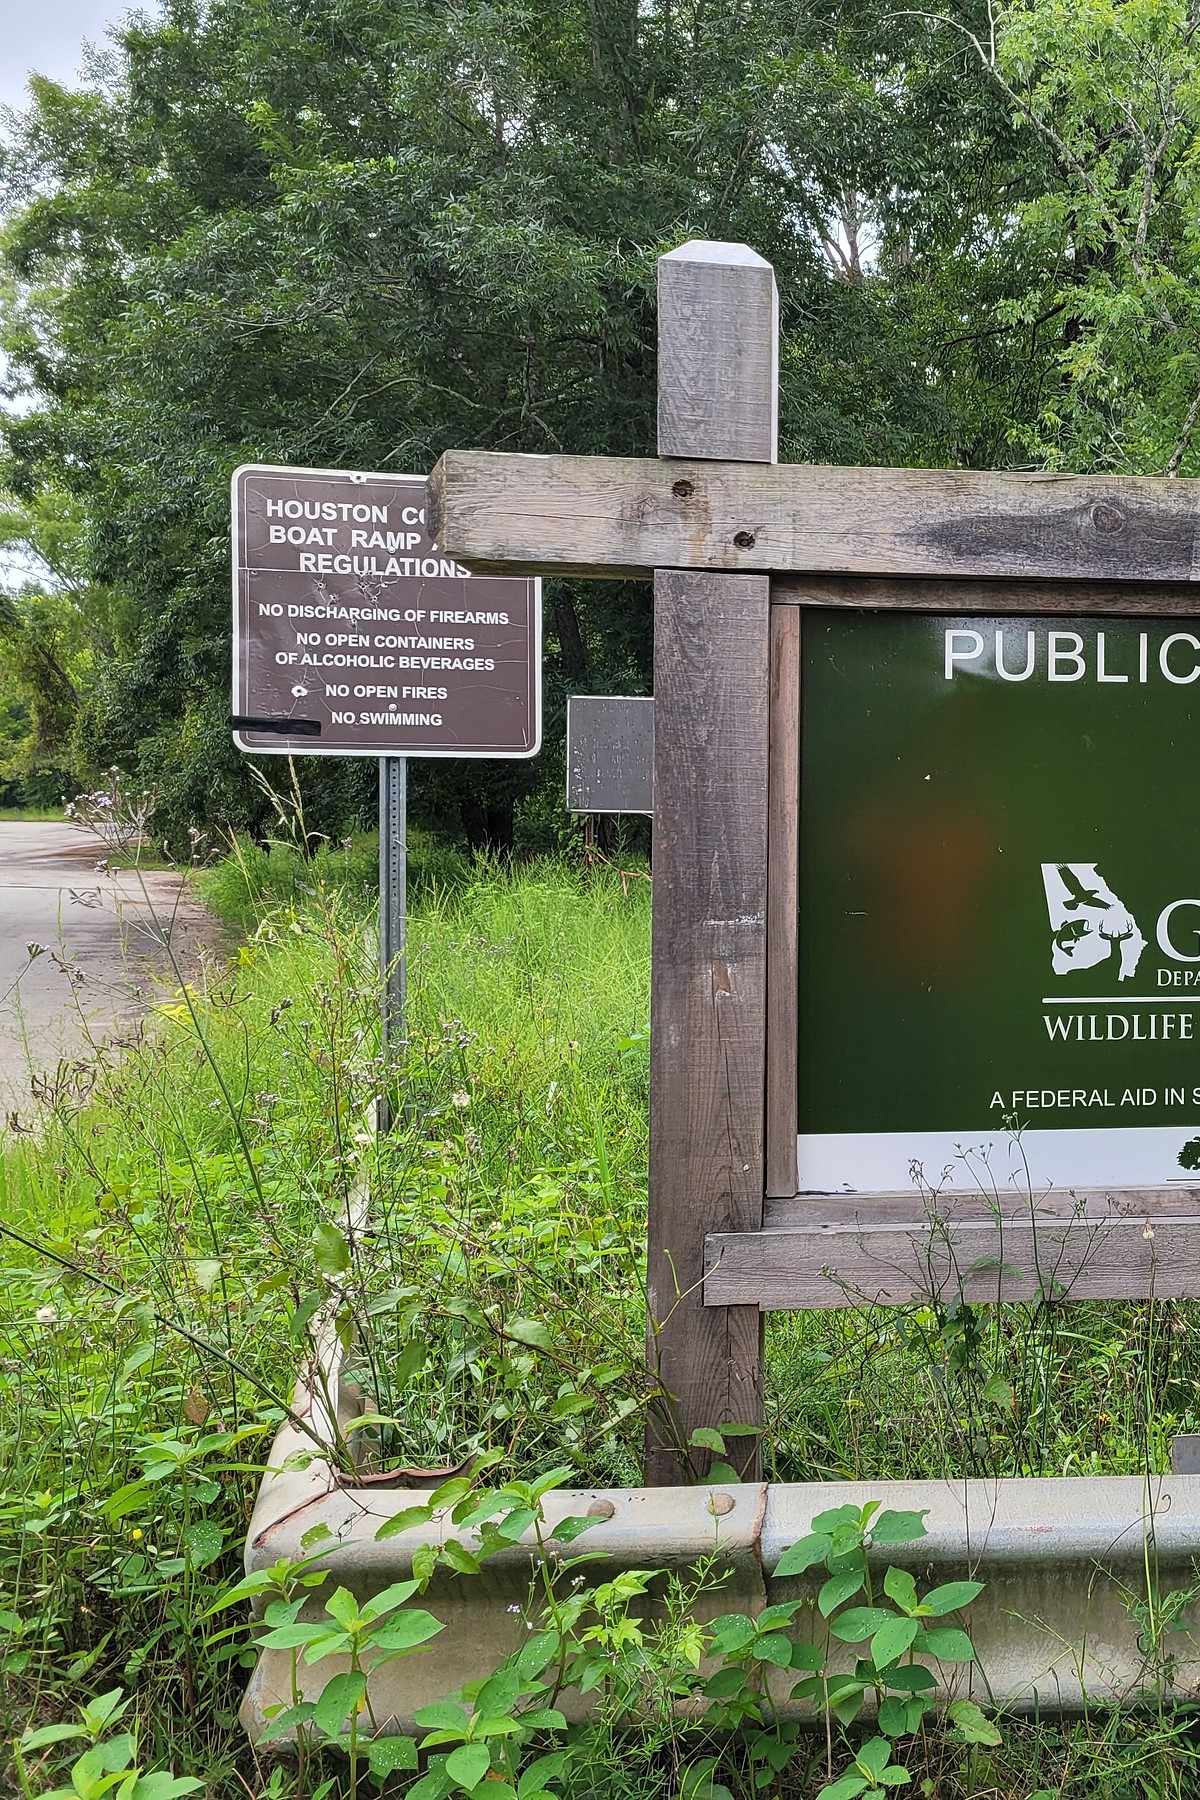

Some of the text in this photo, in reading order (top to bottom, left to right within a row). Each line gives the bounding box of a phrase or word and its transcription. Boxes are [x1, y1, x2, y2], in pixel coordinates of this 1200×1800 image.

[266, 499, 388, 524] HOUSTON
[270, 526, 337, 546] BOAT
[350, 529, 421, 550] RAMP
[259, 604, 509, 624] NO DISCHARGING OF FIREARMS
[297, 633, 474, 650] NO OPEN CONTAINERS
[276, 652, 494, 670] OF ALCOHOLIC BEVERAGES
[326, 684, 447, 699] NO OPEN FIRES
[331, 710, 442, 726] NO SWIMMING
[990, 1092, 1005, 1108] A
[1013, 1089, 1115, 1108] FEDERAL
[1121, 1089, 1156, 1105] AID
[1165, 1088, 1184, 1105] IN
